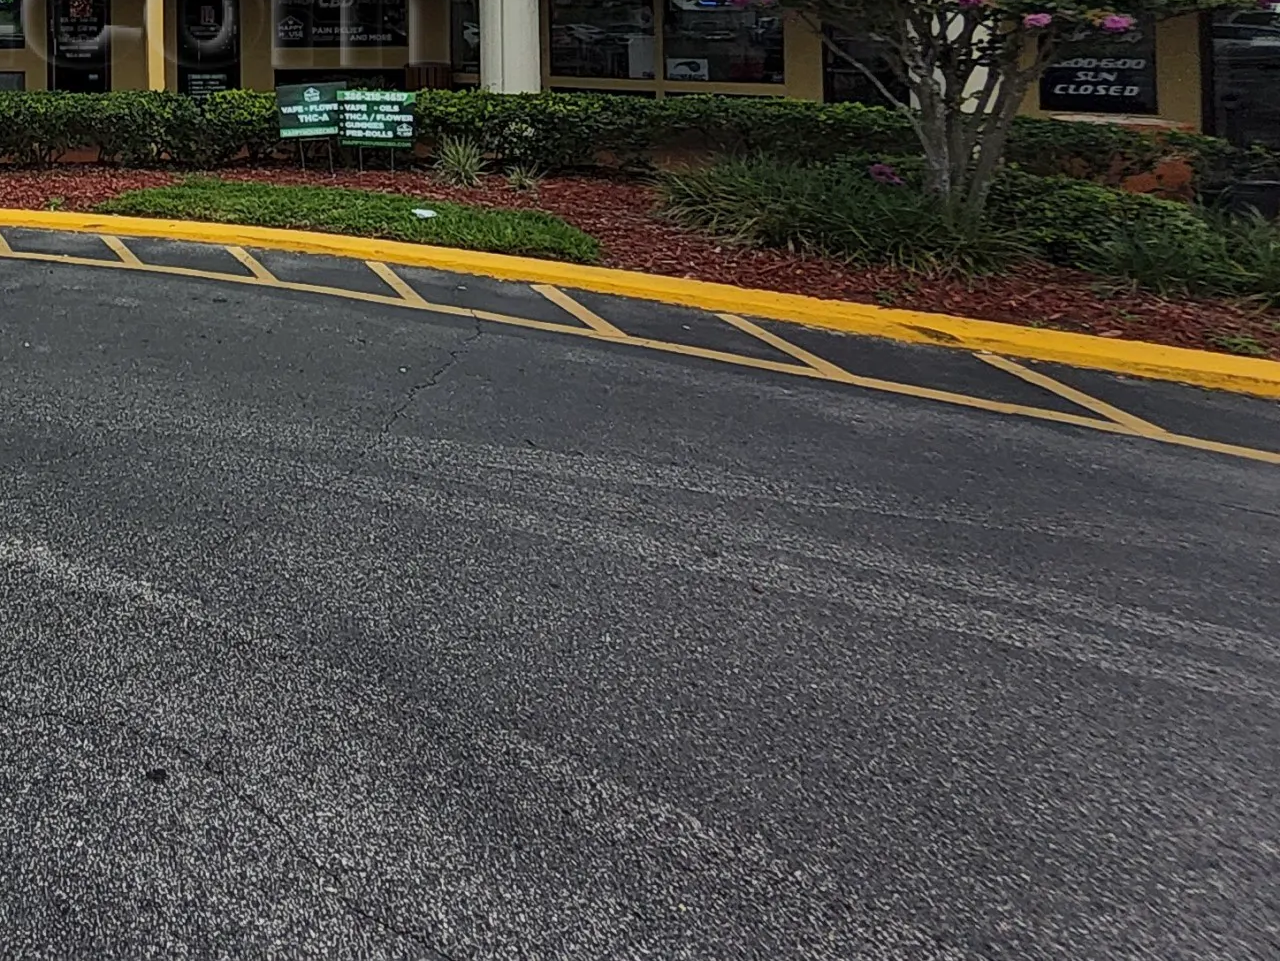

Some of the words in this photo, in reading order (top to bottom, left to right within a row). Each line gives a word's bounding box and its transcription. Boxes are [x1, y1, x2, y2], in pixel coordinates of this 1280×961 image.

[312, 26, 333, 34] PAIN
[1053, 84, 1140, 96] CLOSED
[281, 105, 304, 114] VAPE
[297, 113, 330, 123] THC-A
[376, 114, 413, 122] FLOWER
